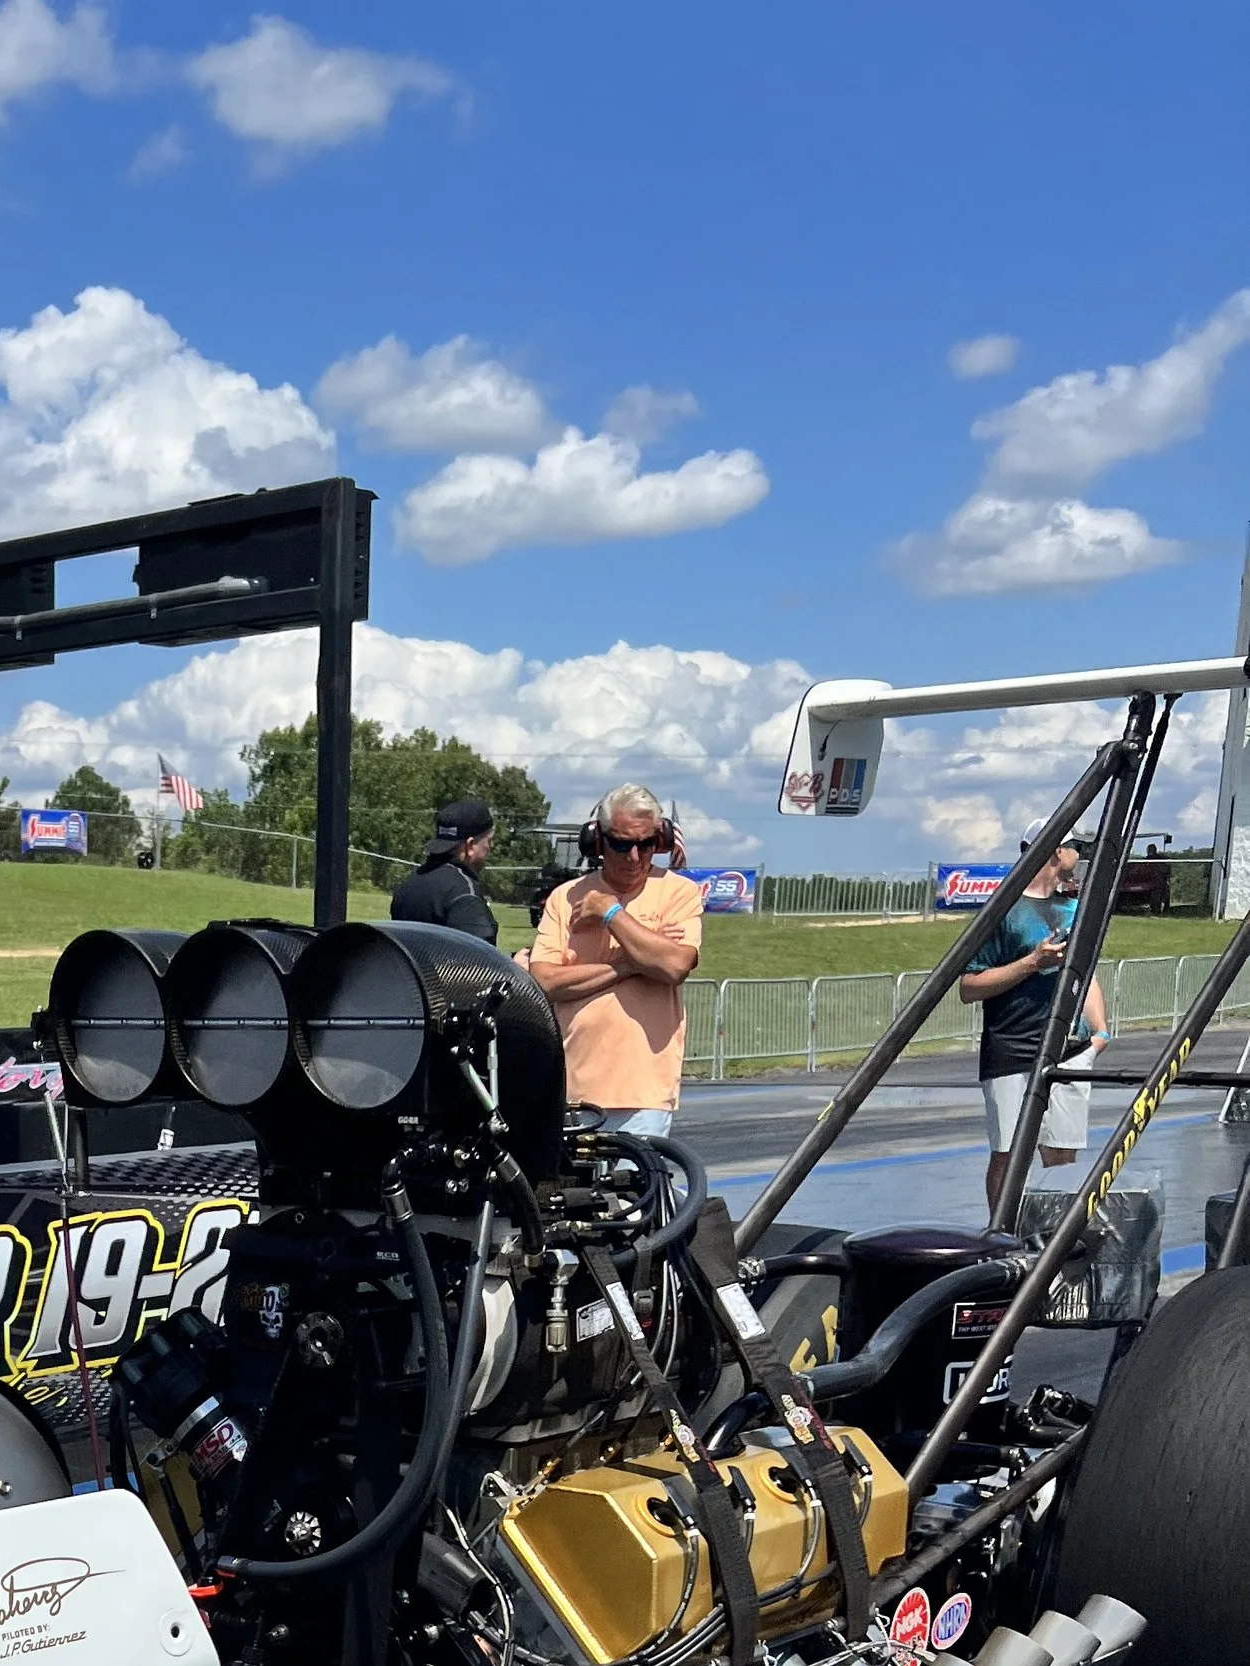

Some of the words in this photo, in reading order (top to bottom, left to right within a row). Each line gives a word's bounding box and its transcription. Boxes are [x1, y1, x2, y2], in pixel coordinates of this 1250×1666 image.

[715, 880, 738, 892] 55
[947, 873, 1001, 898] SUMM
[27, 1208, 250, 1358] 19-2
[1, 1627, 29, 1642] PILOTED
[896, 1604, 924, 1641] NGK
[937, 1602, 967, 1640] NHRA
